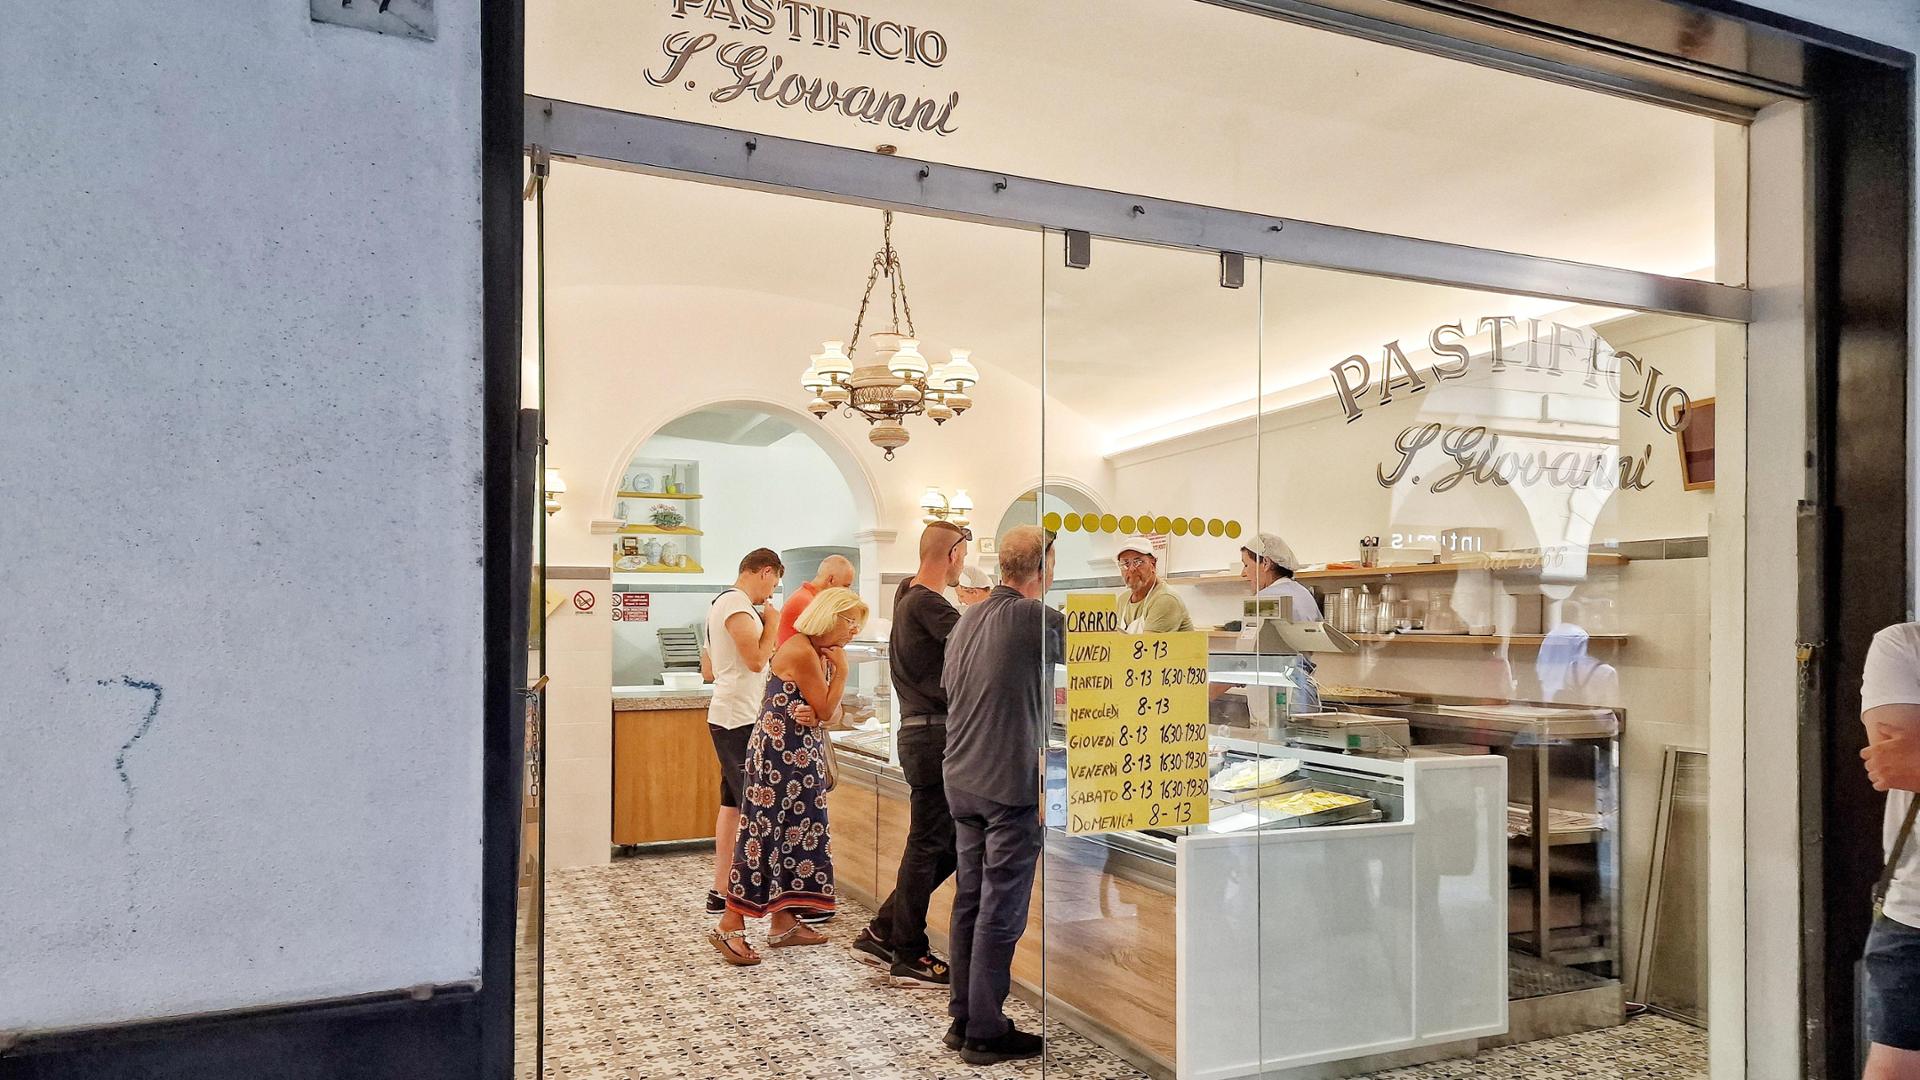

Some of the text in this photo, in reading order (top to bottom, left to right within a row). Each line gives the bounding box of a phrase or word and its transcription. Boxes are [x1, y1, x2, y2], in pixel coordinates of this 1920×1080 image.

[643, 30, 959, 137] S. Giovanni
[1330, 315, 1692, 434] PASTIFICIO
[1376, 422, 1655, 494] S. Giovanni
[1067, 608, 1118, 632] ORARIO
[1071, 790, 1119, 805] SABATO
[1072, 813, 1133, 833] DOMENICA
